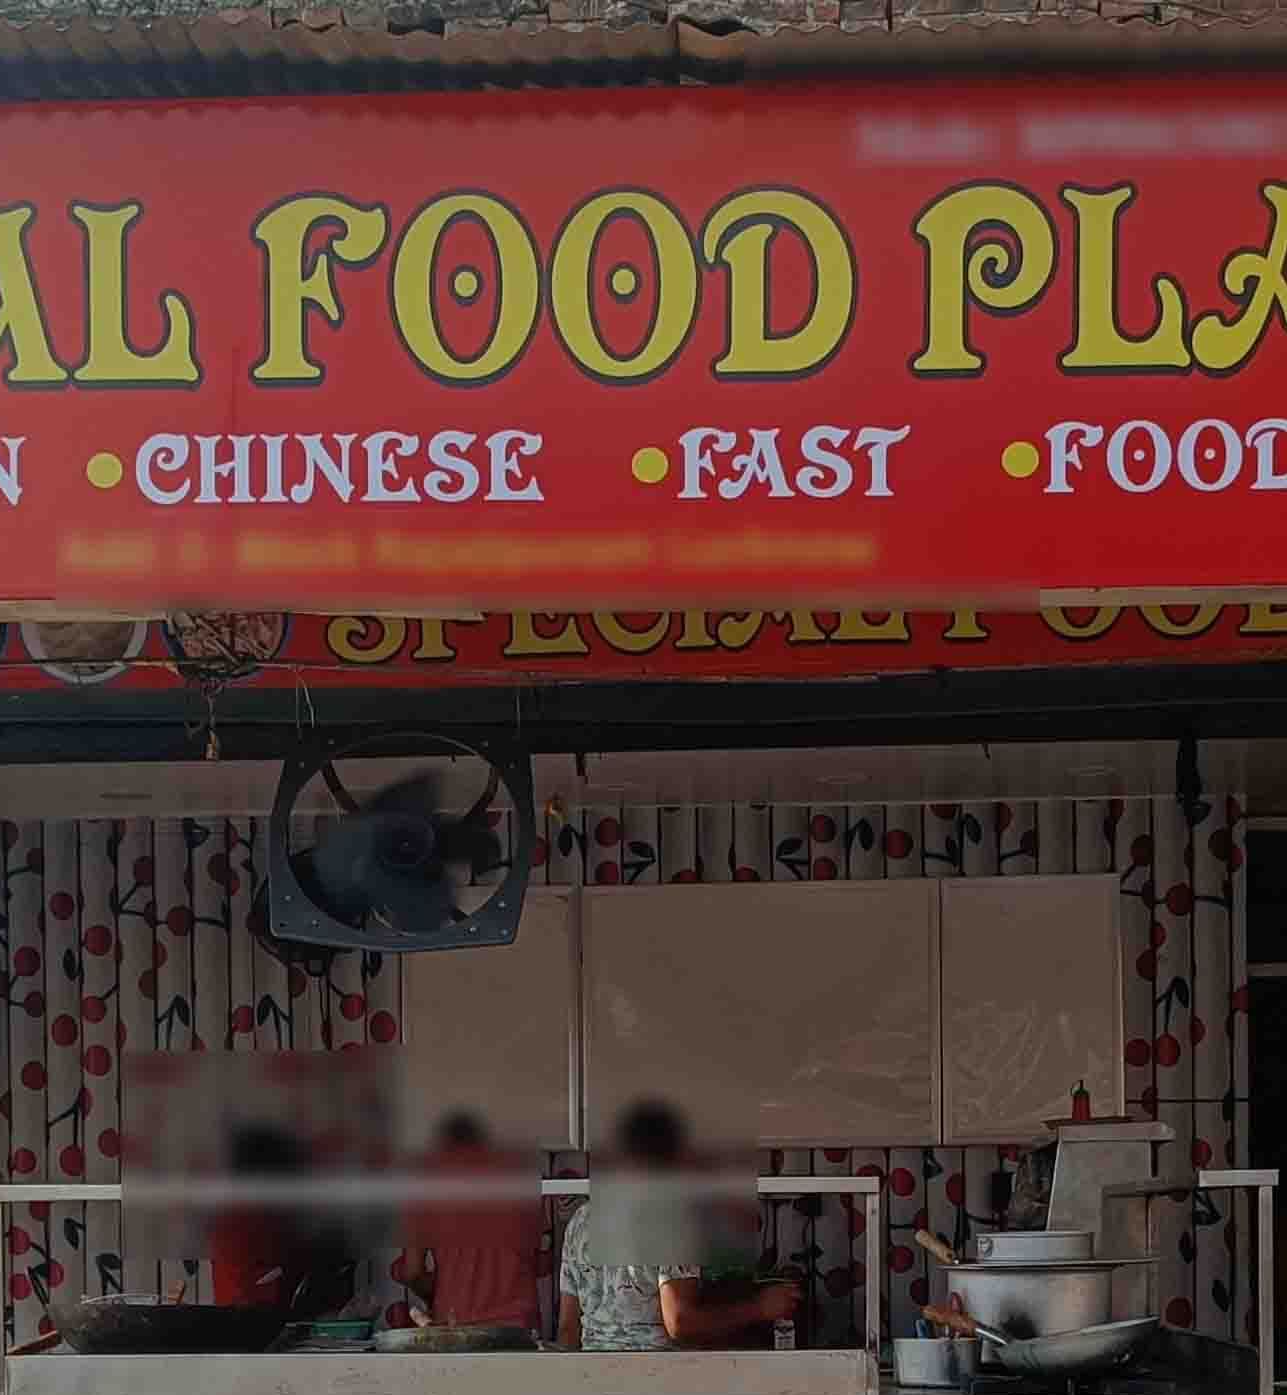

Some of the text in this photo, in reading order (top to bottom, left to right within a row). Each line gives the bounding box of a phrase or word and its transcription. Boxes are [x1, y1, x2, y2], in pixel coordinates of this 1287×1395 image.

[250, 186, 858, 384] FOOD
[133, 429, 547, 507] CHINESE
[676, 424, 911, 501] FAST
